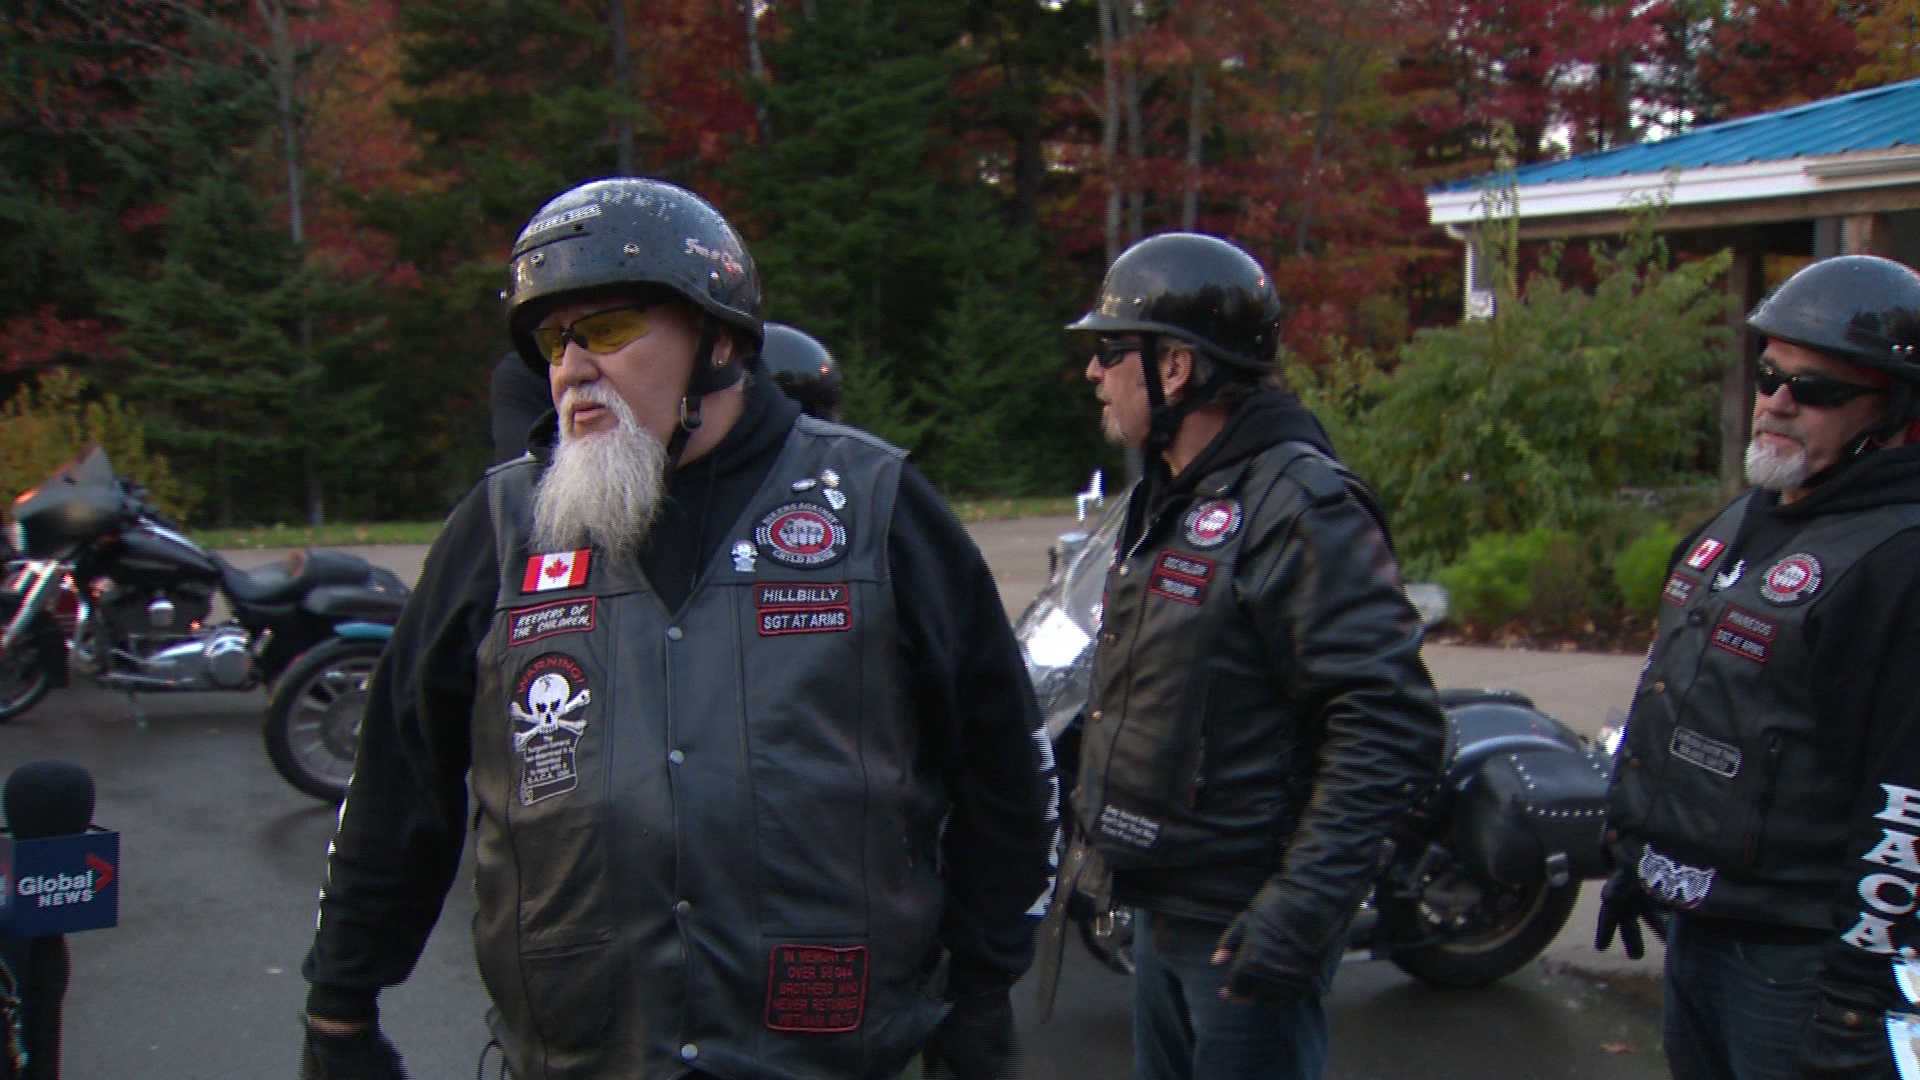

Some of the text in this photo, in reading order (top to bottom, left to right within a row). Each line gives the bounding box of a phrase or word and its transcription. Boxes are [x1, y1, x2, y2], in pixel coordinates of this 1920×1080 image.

[797, 502, 838, 524] AGAINST
[772, 549, 804, 563] CHILD
[763, 588, 839, 602] HILLBILLY
[517, 604, 588, 627] KEEPERS OF
[763, 612, 845, 630] SGT AT ARMS
[513, 626, 533, 640] THE
[517, 656, 586, 694] WARNING!
[17, 868, 95, 896] Global
[37, 887, 95, 908] NEWS
[784, 948, 796, 963] IN
[788, 966, 816, 978] OVER
[779, 981, 858, 994] BROTHERS WHO
[774, 998, 808, 1010] NEVER
